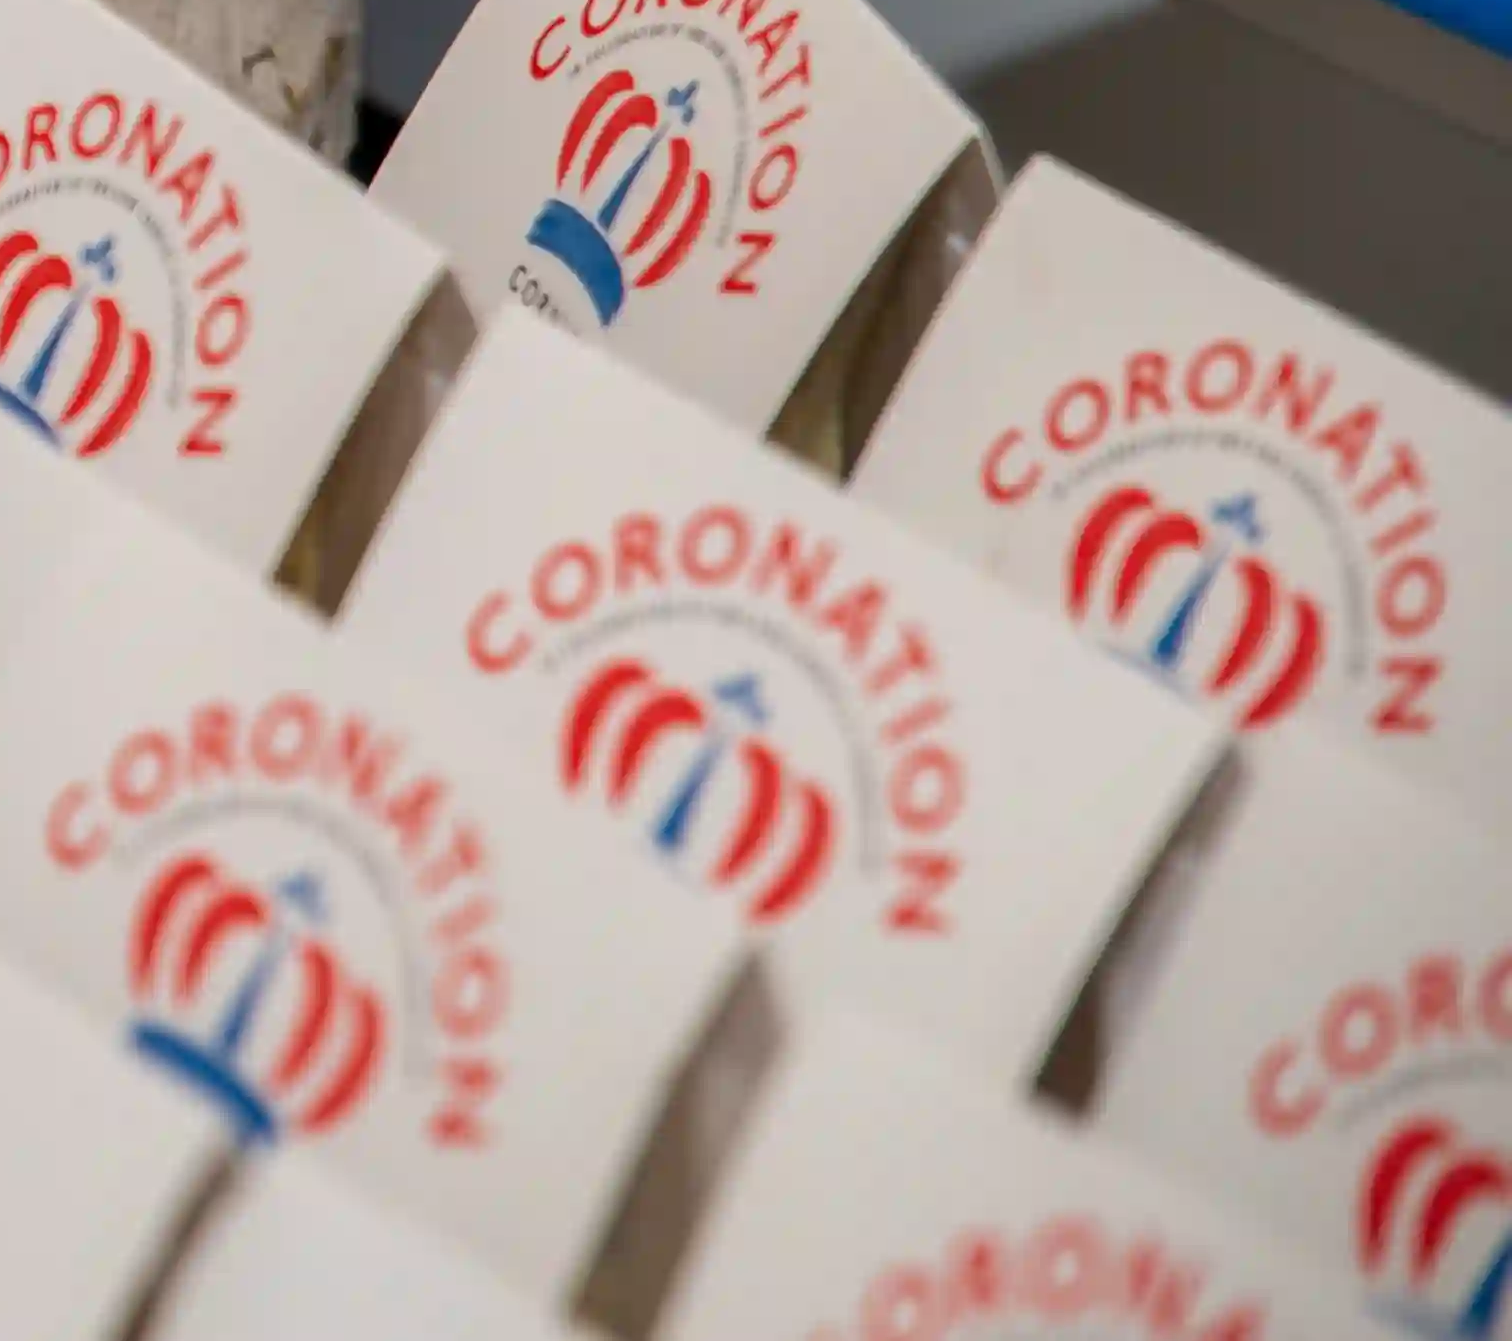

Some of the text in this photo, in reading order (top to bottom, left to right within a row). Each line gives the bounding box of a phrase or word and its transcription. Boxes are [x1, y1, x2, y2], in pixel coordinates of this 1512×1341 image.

[464, 505, 963, 937] CORONATION
[978, 338, 1447, 737] CORONATION
[44, 693, 510, 1150] CORONATION
